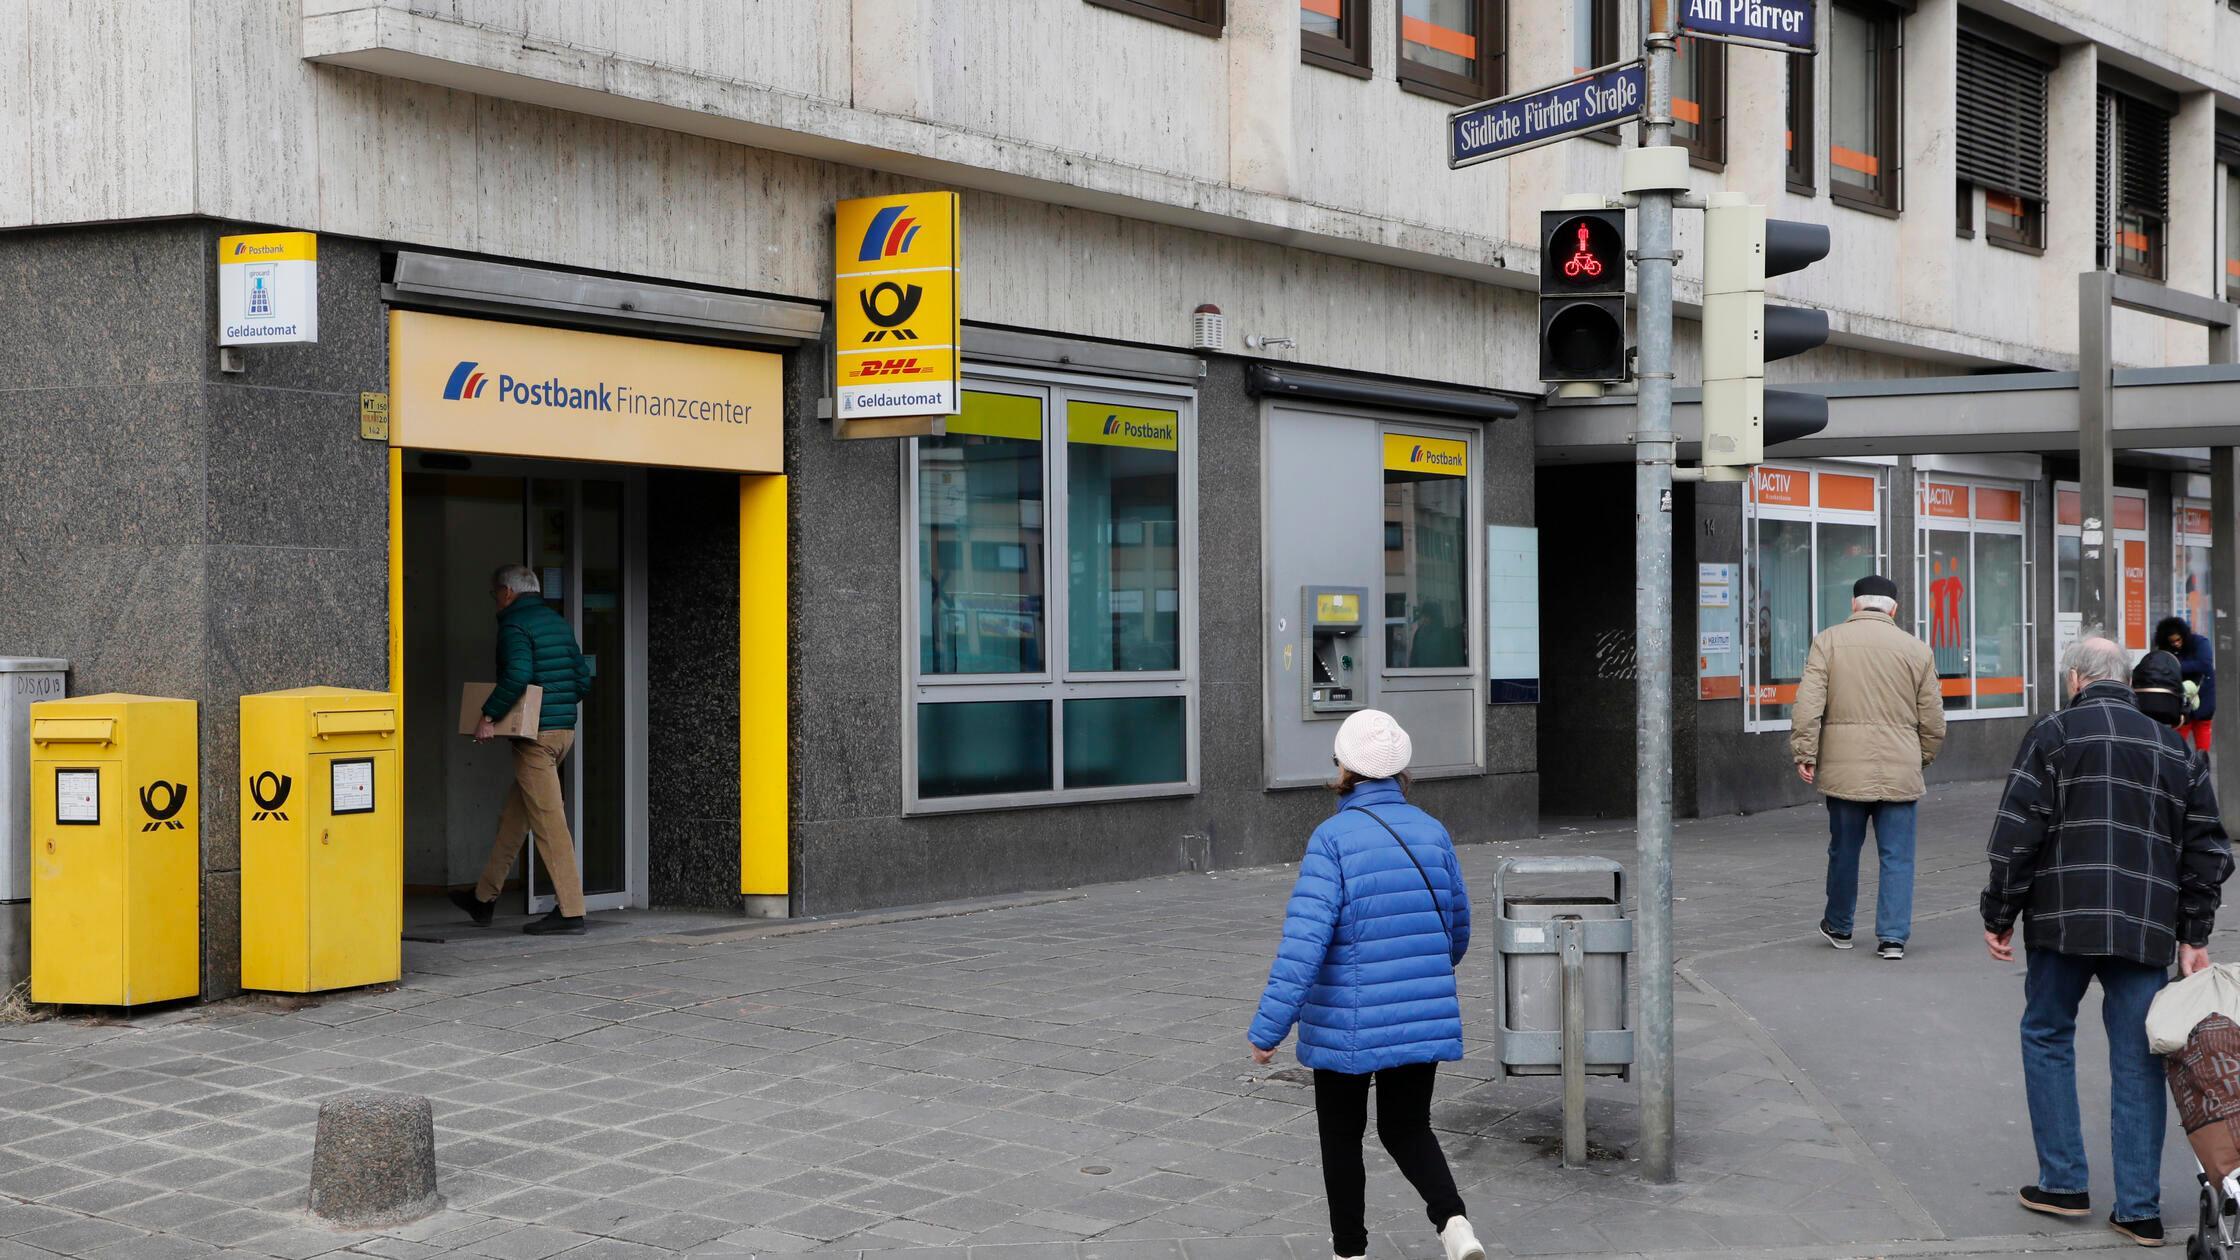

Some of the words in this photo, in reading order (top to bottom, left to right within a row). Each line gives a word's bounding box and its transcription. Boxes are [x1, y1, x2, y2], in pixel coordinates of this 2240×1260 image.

[1689, 0, 1722, 21] Am
[1730, 0, 1804, 33] Plärrer
[1461, 110, 1520, 151] Südliche
[1524, 96, 1580, 134] Fürther
[1584, 76, 1637, 117] Straße
[248, 244, 284, 255] Postbank
[227, 324, 297, 338] Geldautomat
[859, 358, 922, 377] DHL
[499, 374, 612, 412] Postbank
[617, 386, 752, 425] Finanzcenter
[857, 392, 942, 408] Geldautomat
[1124, 421, 1172, 440] Postbank
[1426, 450, 1463, 467] Postbank
[1922, 488, 1954, 505] VACTIV
[1704, 519, 1715, 537] 14
[17, 676, 50, 696] DISKO
